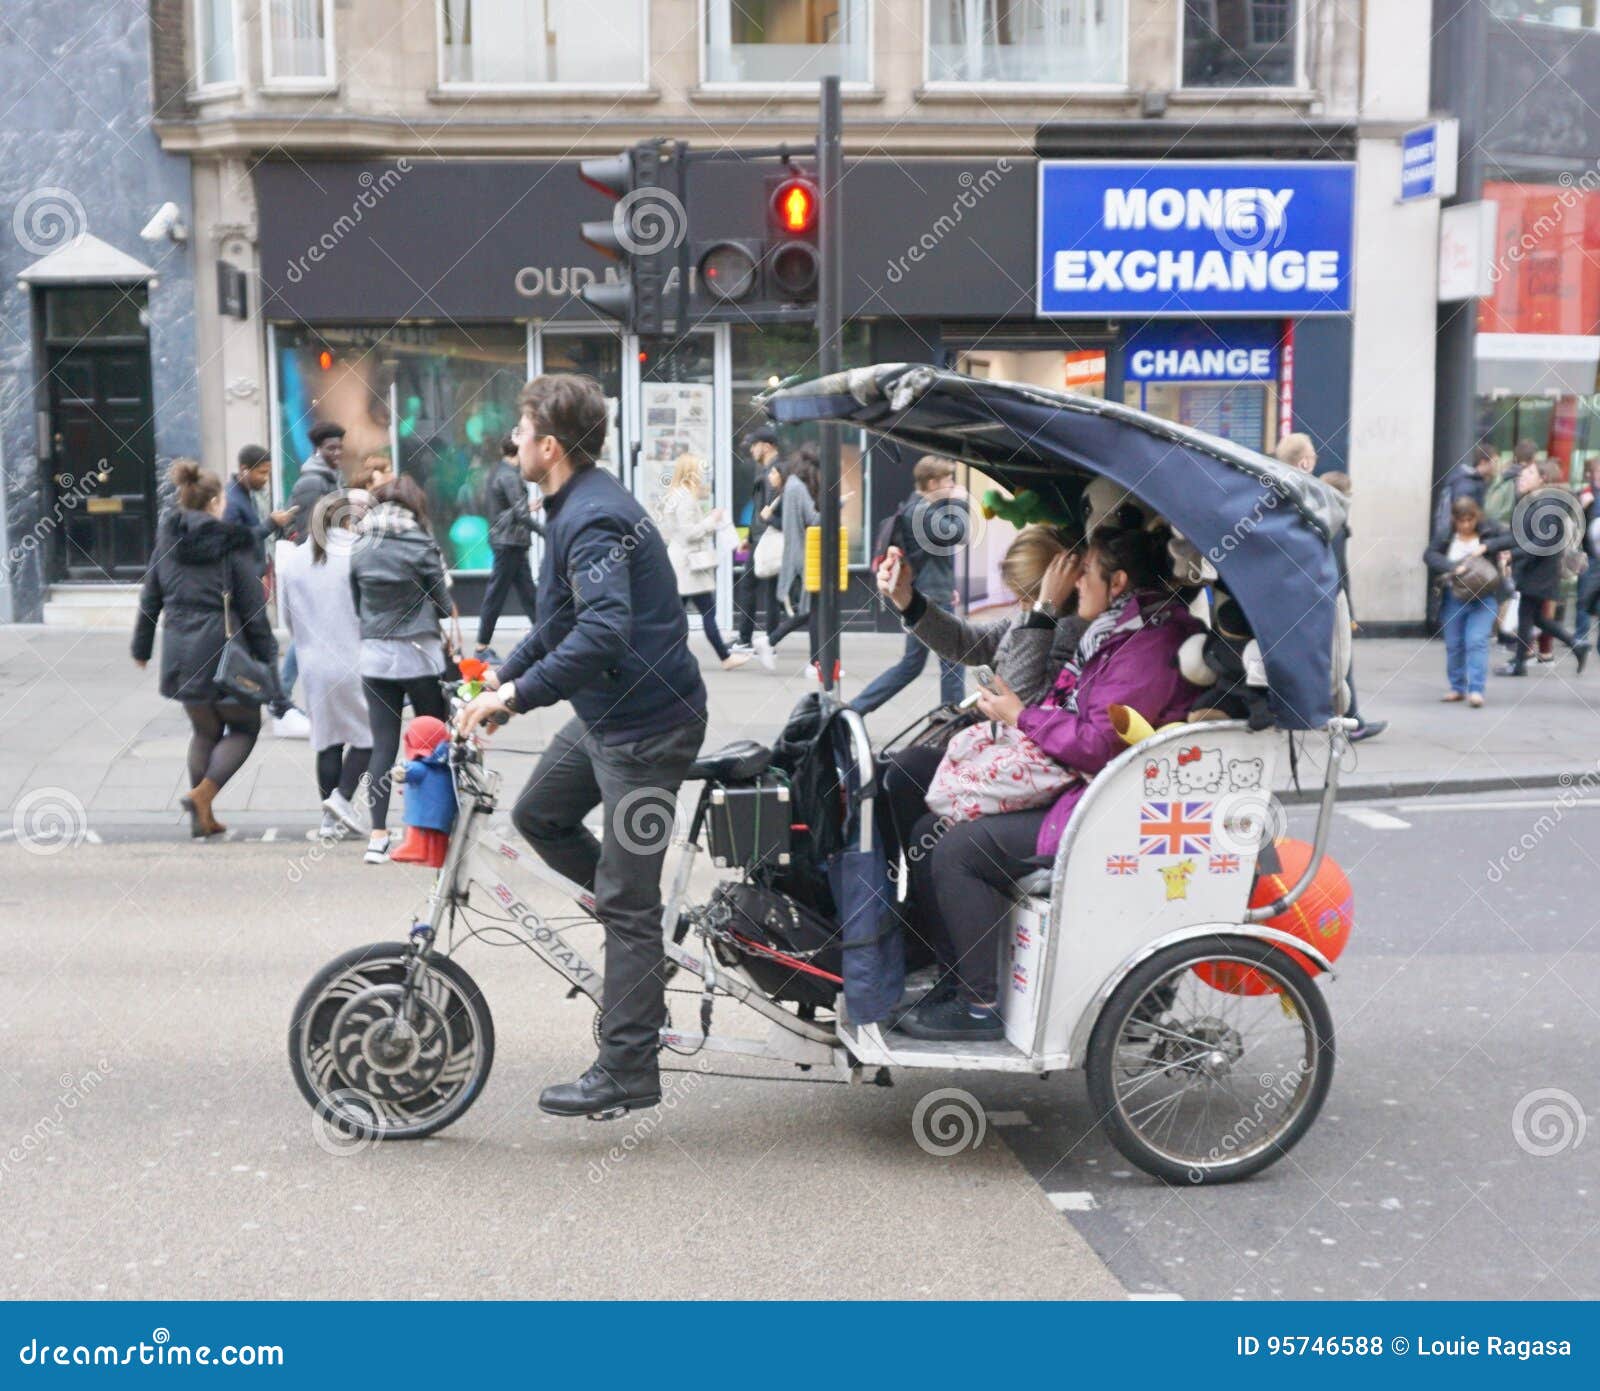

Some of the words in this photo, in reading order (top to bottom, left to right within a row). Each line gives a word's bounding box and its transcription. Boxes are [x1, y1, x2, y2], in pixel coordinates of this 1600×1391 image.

[1104, 187, 1294, 231] MONEY
[1054, 249, 1339, 292] EXCHANGE
[1132, 349, 1271, 377] CHANGE
[1281, 345, 1294, 437] CHANG
[508, 902, 594, 982] ECOTAXI
